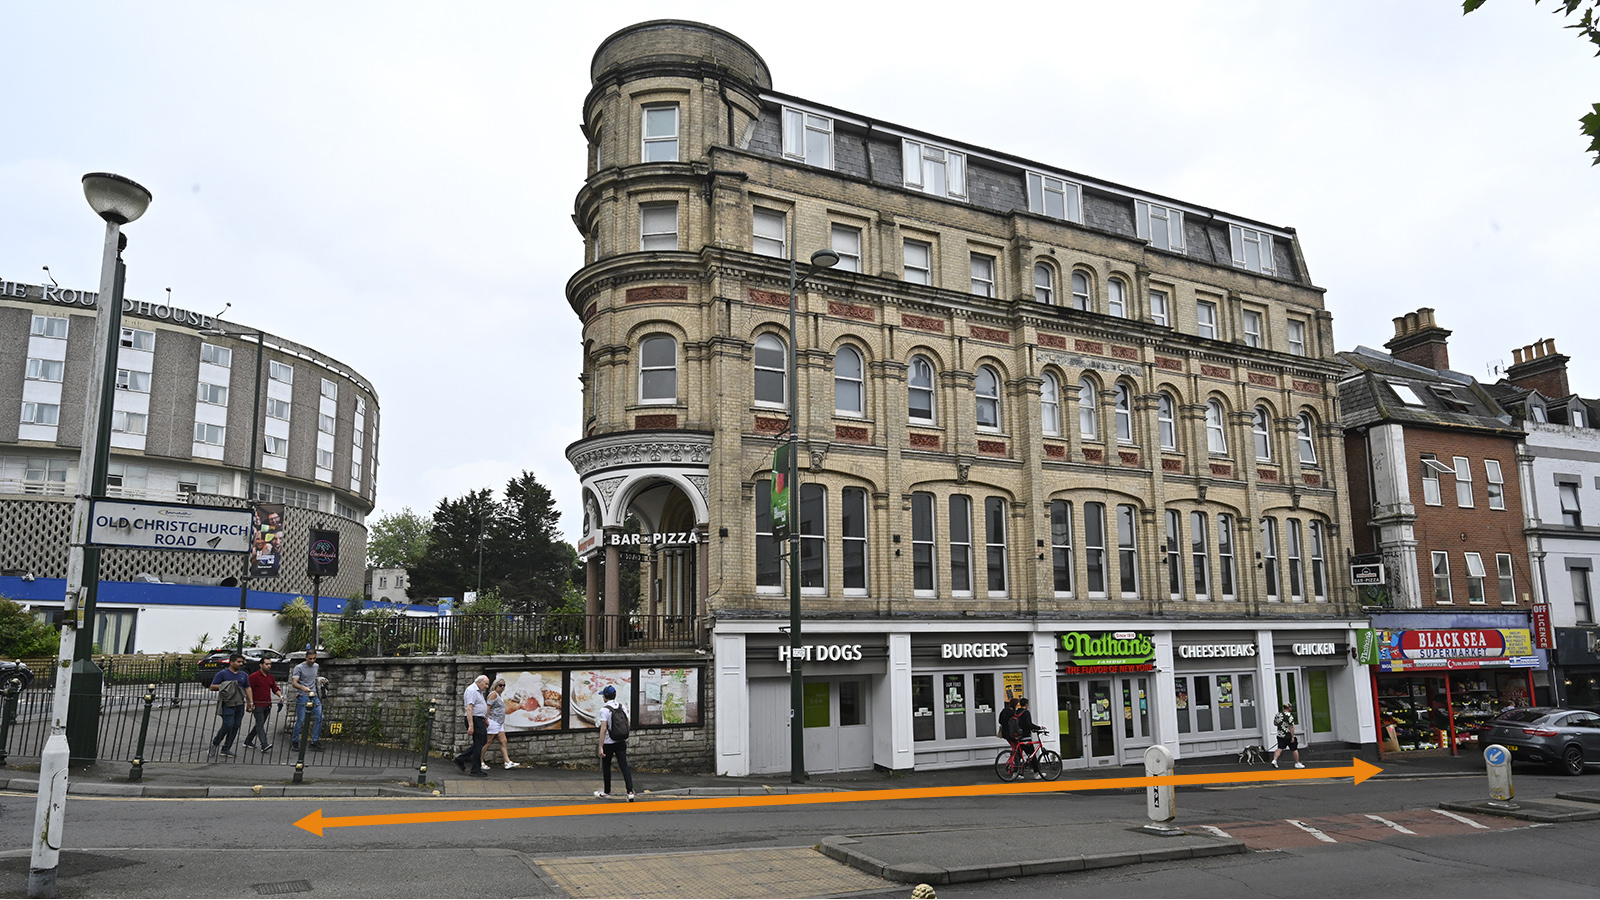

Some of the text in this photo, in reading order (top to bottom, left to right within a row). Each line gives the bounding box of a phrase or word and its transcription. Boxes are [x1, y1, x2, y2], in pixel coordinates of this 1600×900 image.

[40, 282, 214, 330] ROUDHOUSE
[96, 515, 249, 537] OLD CHRISTCHURCH
[154, 533, 197, 547] ROAD
[611, 532, 698, 546] BAR PIZZA
[1533, 605, 1548, 648] OFF LICENCE
[1061, 632, 1153, 656] Nathan's
[1418, 631, 1487, 648] BLACK SEA
[778, 645, 814, 661] HT
[816, 644, 862, 661] DOGS
[941, 643, 1009, 658] BURGERS
[1179, 643, 1255, 658] CHEESESTEAKS
[1292, 642, 1336, 656] CHICKEN
[1419, 648, 1487, 659] SUPERMARKET
[1120, 665, 1136, 673] NEW
[1136, 664, 1154, 672] YORK
